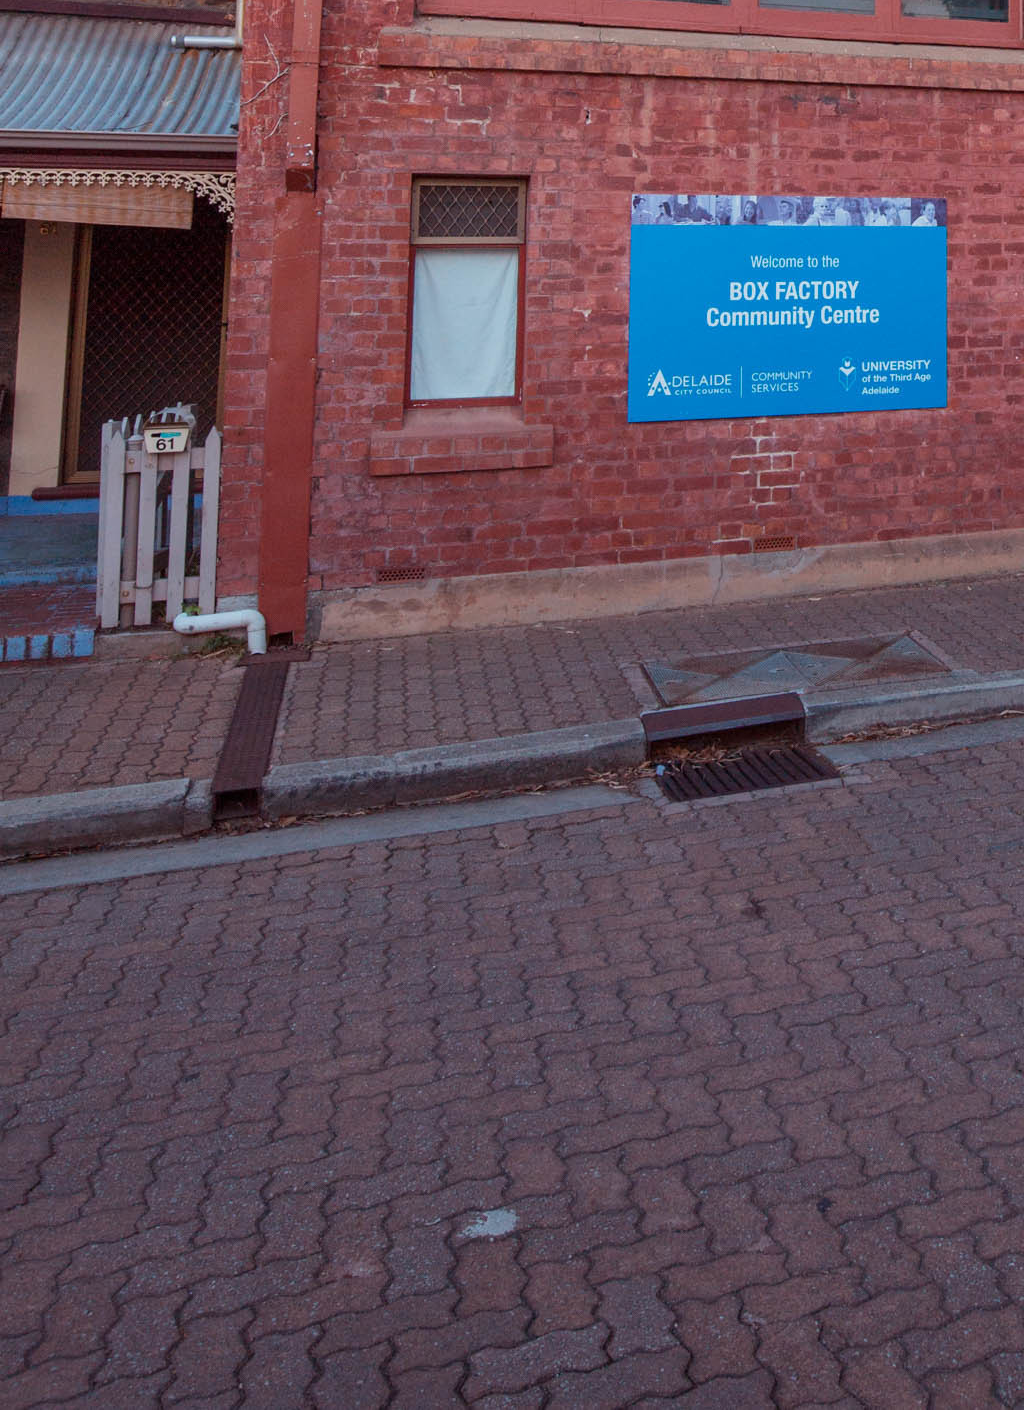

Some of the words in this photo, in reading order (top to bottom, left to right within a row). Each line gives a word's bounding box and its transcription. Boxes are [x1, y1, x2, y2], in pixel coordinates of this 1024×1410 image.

[751, 255, 804, 268] Welcome
[807, 255, 818, 268] to
[822, 255, 840, 268] the
[729, 281, 769, 301] BOX
[775, 280, 860, 300] FACTORY
[706, 306, 815, 329] Community
[820, 305, 880, 324] Centre
[861, 359, 931, 372] UNIVERSITY
[751, 370, 812, 382] COMMUNITY
[861, 374, 871, 383] of
[873, 374, 888, 383] the
[890, 373, 912, 382] Third
[914, 373, 931, 382] Age
[696, 387, 732, 395] COUNCIL
[751, 382, 800, 393] SERVICES
[861, 386, 900, 396] Adelaide
[156, 438, 174, 451] 61
